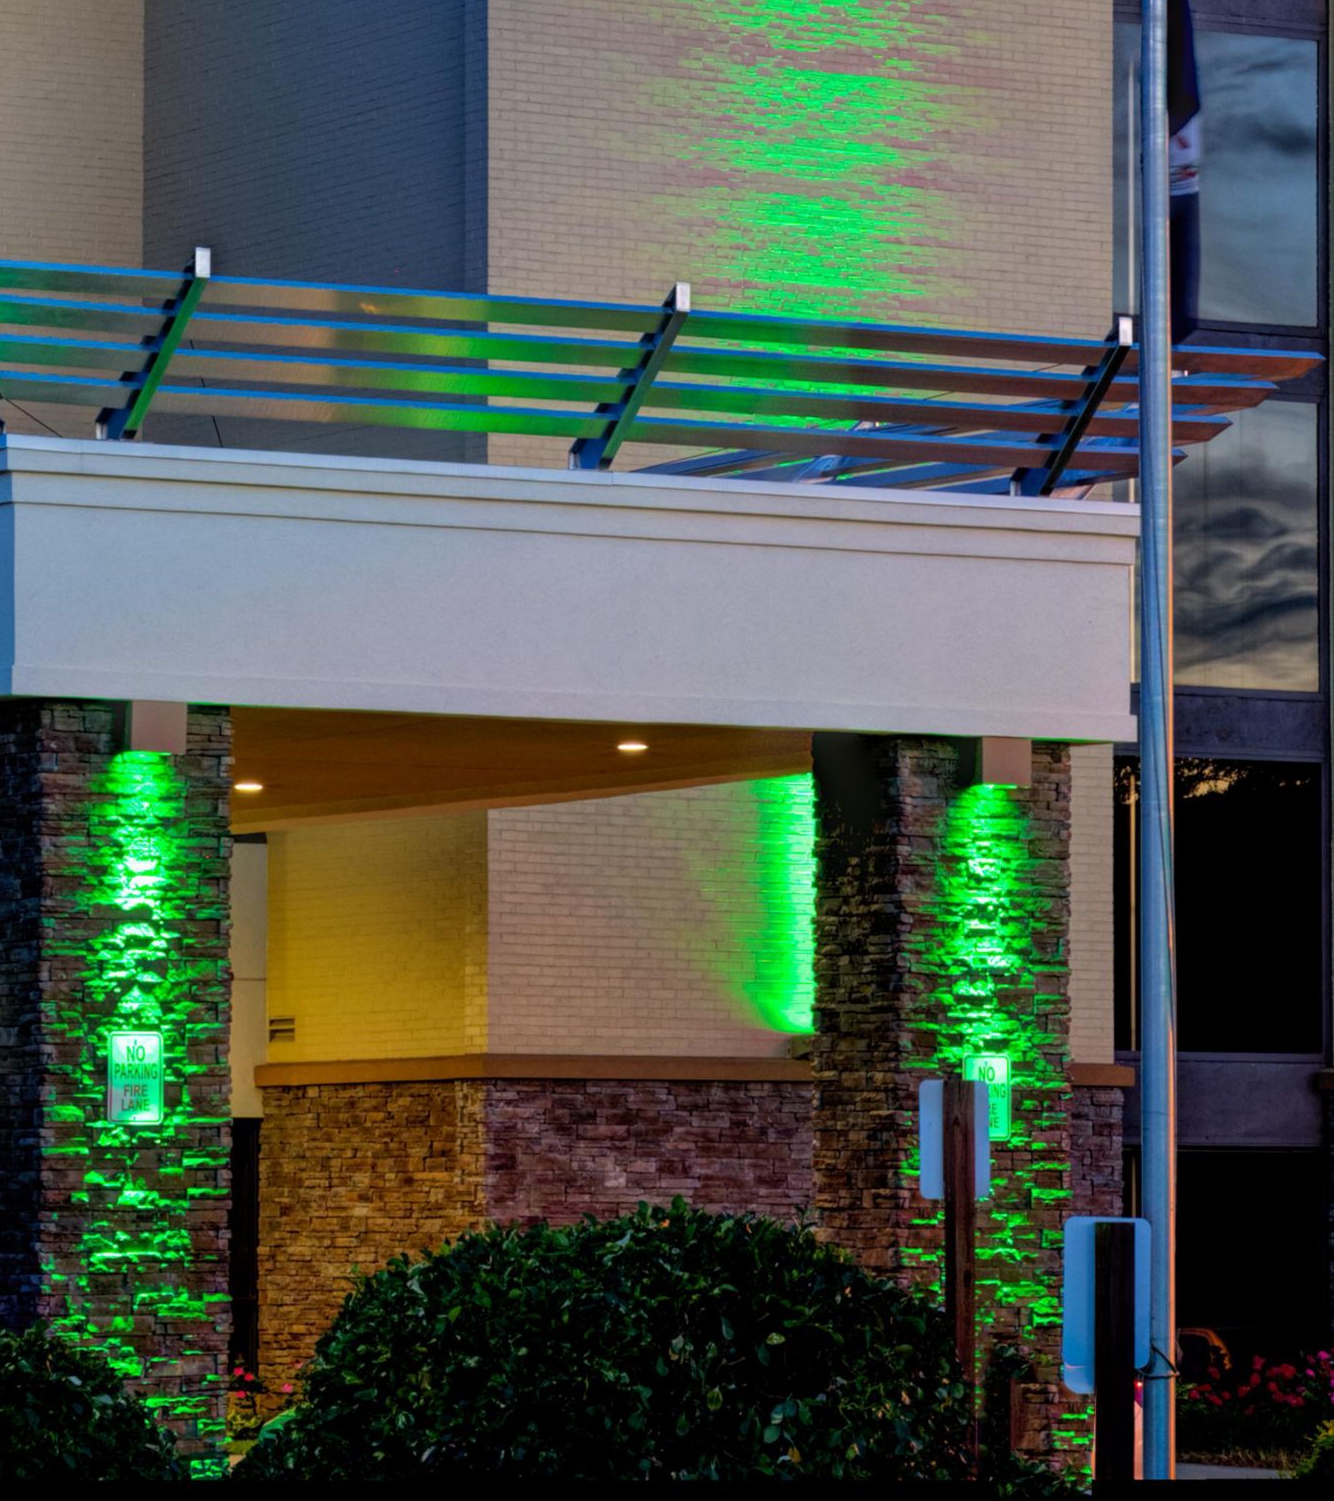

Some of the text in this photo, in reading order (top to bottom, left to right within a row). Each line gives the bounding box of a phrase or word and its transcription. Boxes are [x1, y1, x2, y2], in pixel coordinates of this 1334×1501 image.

[126, 1045, 146, 1061] NO
[114, 1063, 158, 1080] PARKING
[978, 1066, 995, 1082] NO
[124, 1084, 148, 1097] FIRE
[121, 1098, 150, 1112] LANE
